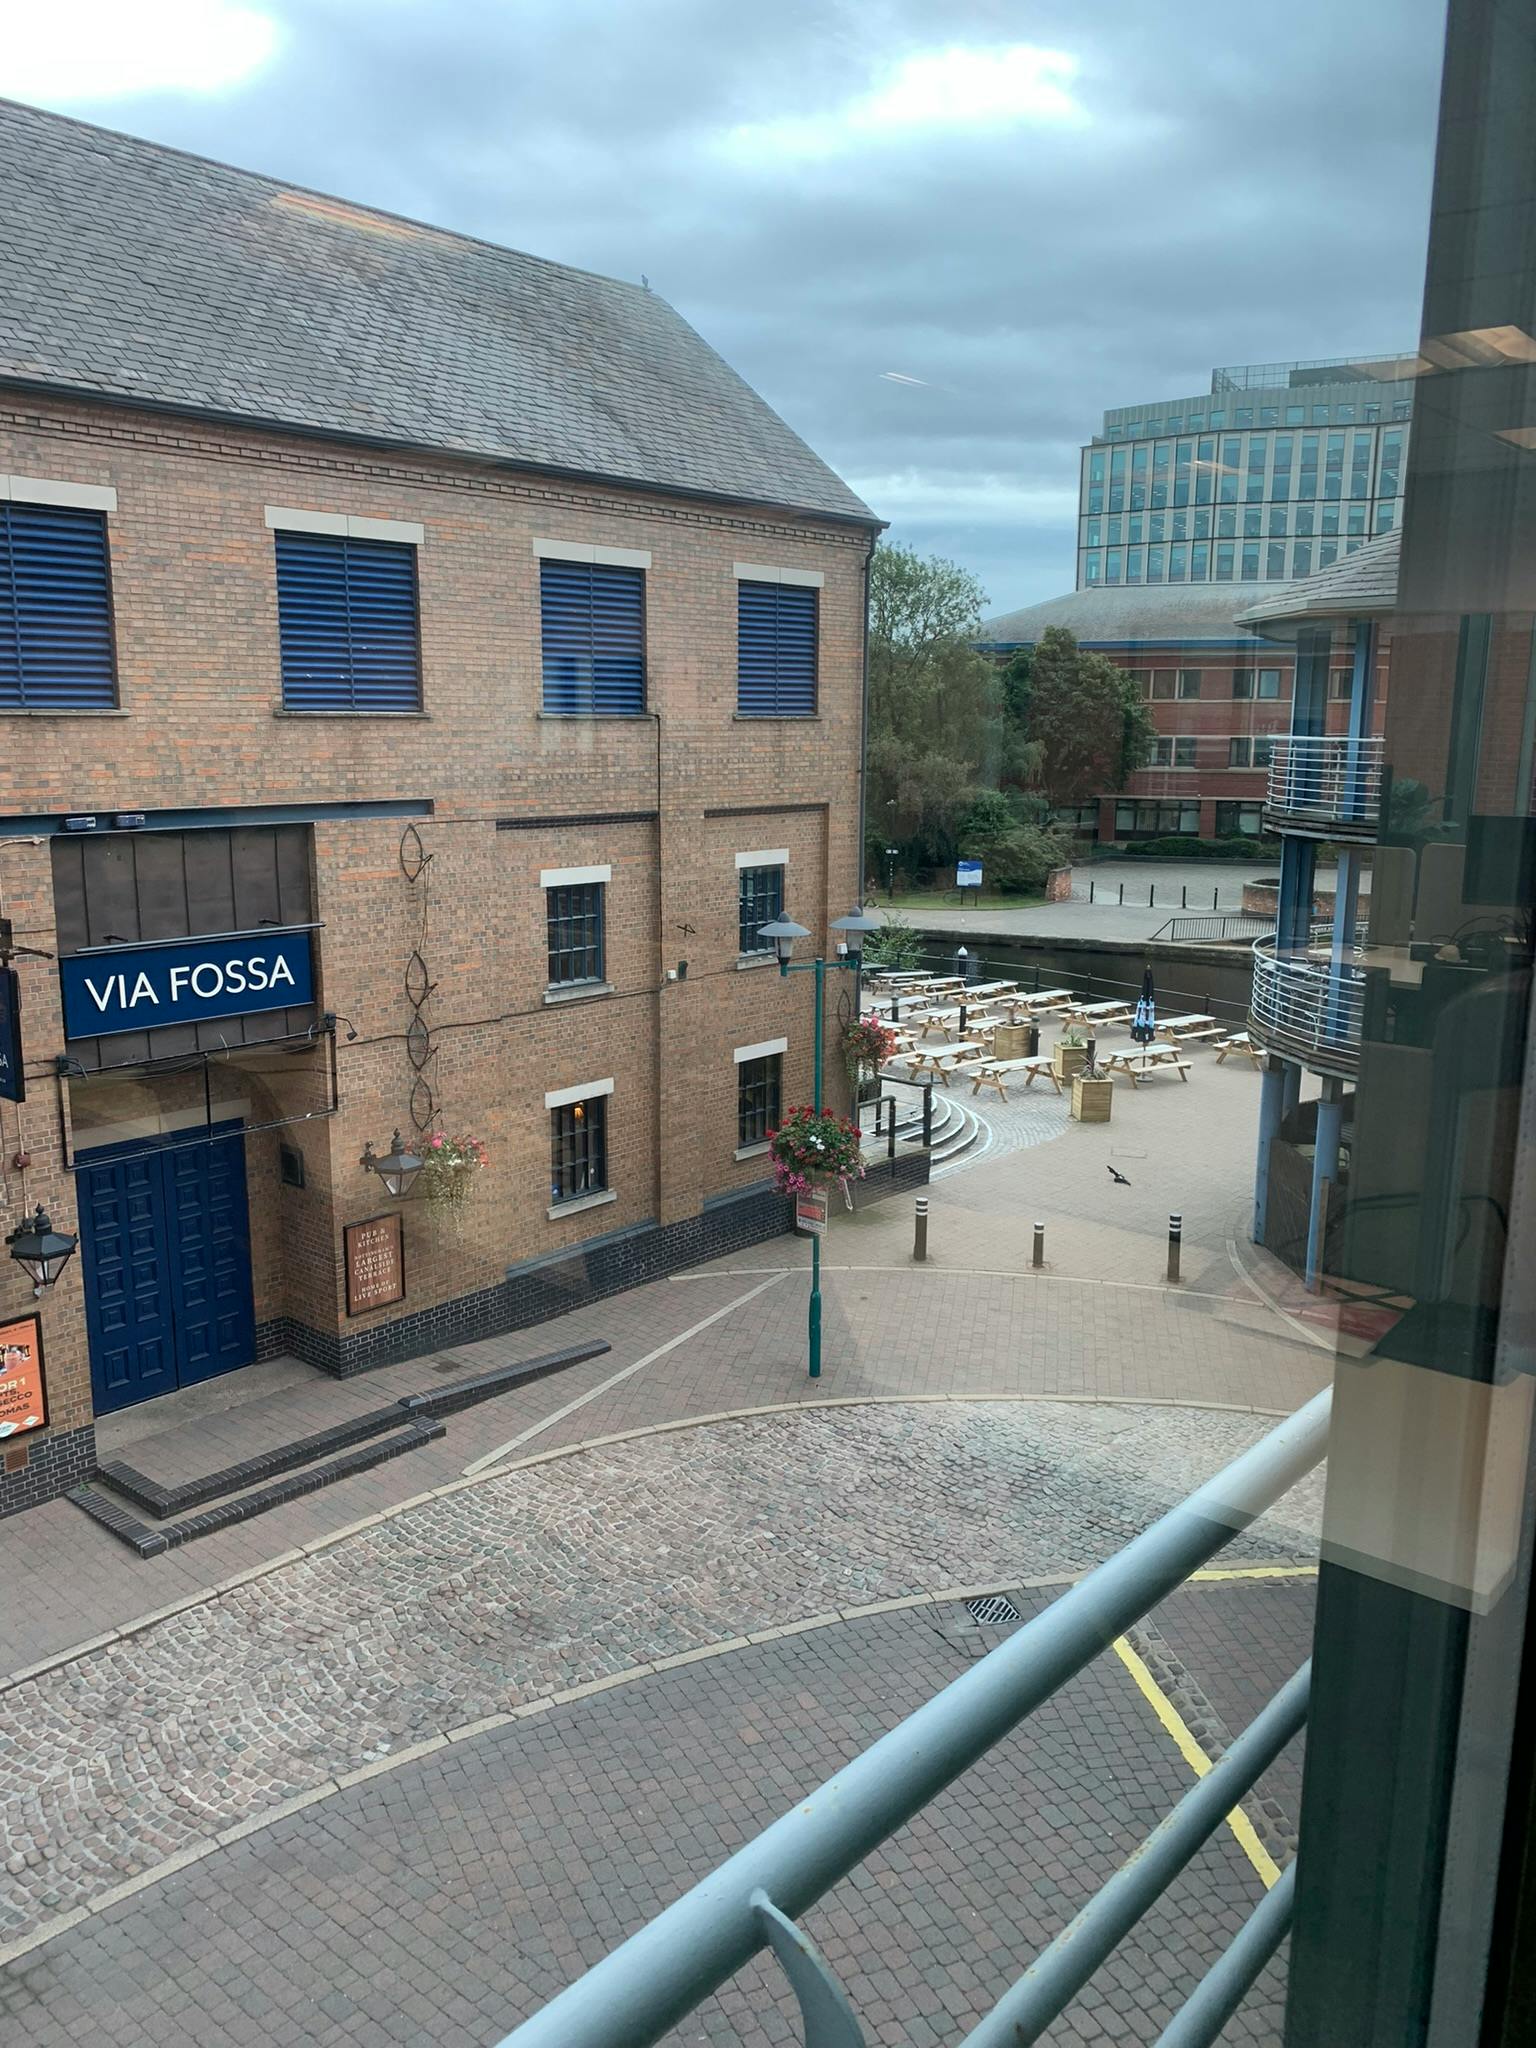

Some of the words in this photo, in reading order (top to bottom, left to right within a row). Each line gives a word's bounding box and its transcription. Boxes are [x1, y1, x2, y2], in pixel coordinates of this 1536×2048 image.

[84, 972, 160, 1012] VIA
[169, 954, 296, 1002] FOSSA
[357, 1234, 389, 1248] KITCHEN
[361, 1229, 377, 1240] PUB
[354, 1258, 394, 1276] CANALSIDE
[355, 1251, 393, 1268] LARGEST
[358, 1266, 391, 1281] TERRACE
[354, 1291, 373, 1302] LIVE
[374, 1282, 397, 1296] SPORT
[361, 1282, 379, 1293] HOME
